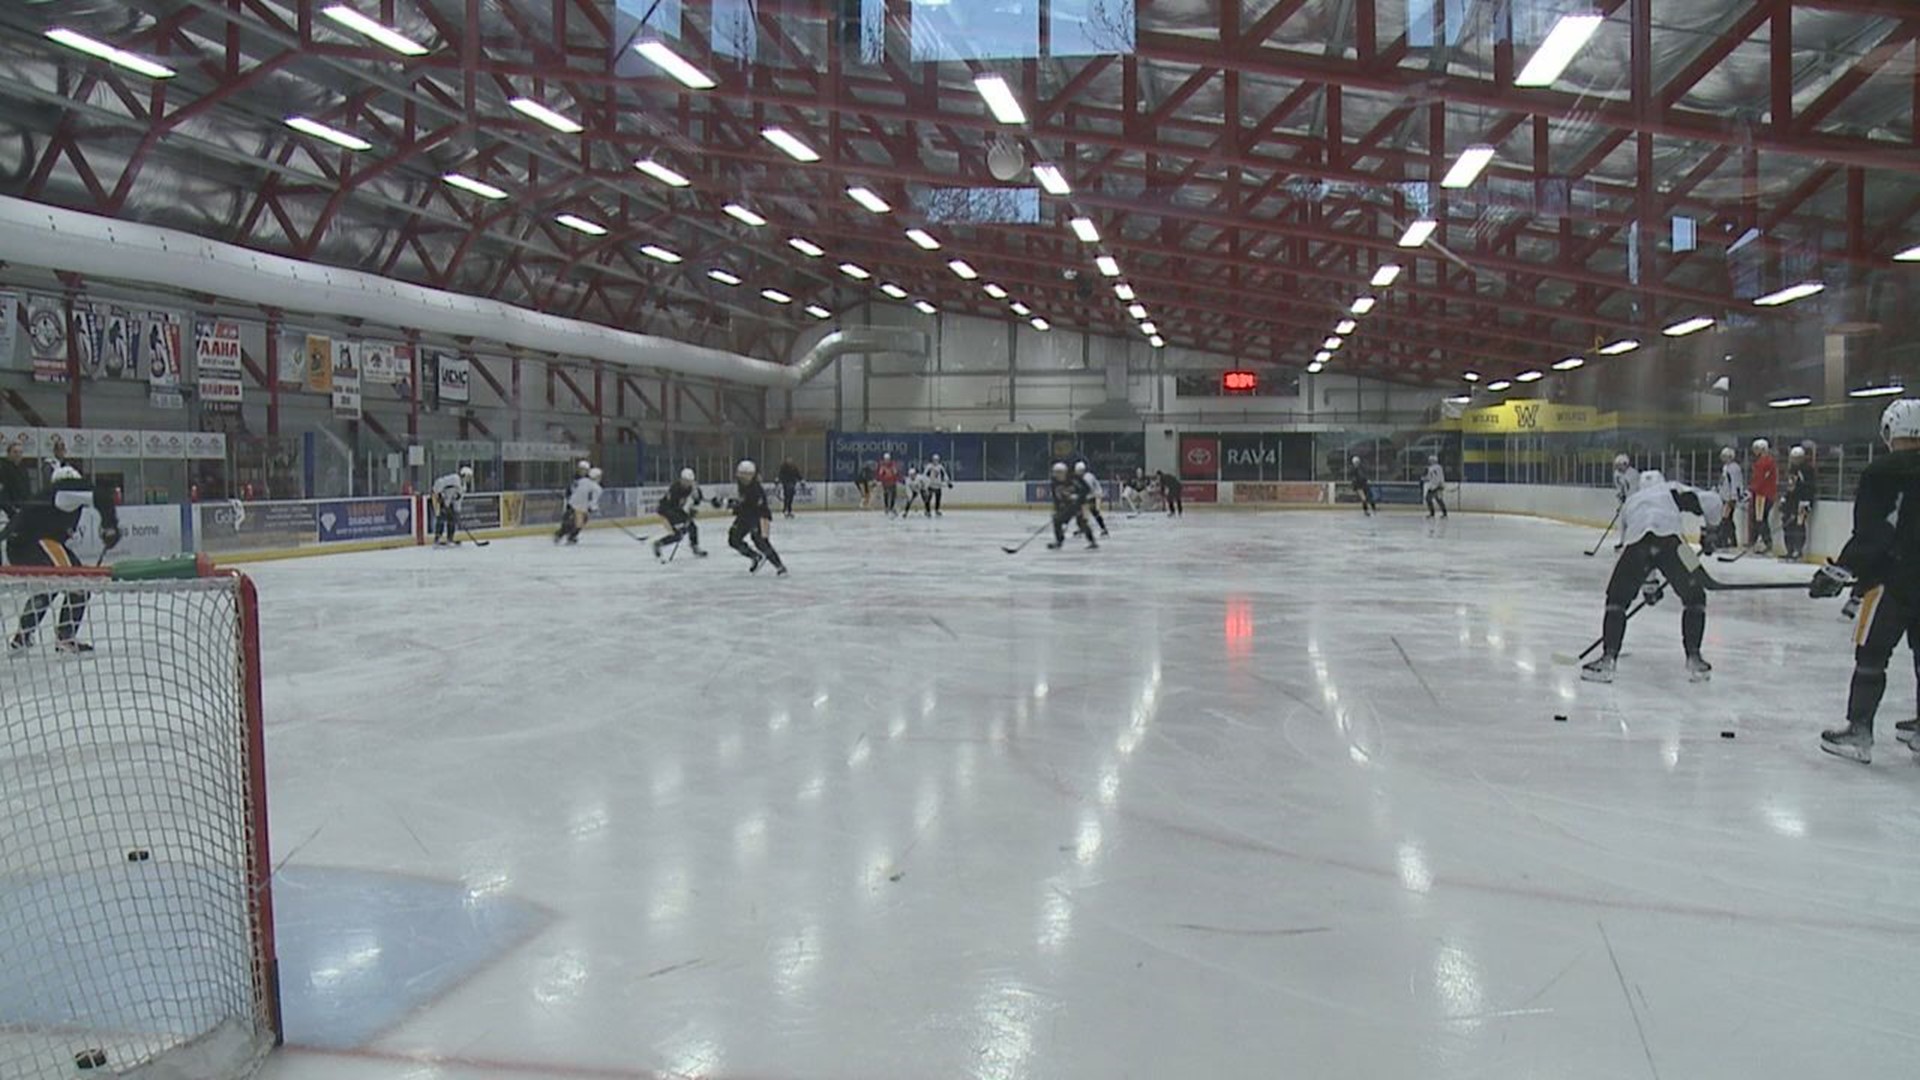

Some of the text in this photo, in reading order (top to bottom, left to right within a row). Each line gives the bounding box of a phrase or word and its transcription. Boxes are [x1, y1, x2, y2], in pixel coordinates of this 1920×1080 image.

[1514, 404, 1539, 428] W
[836, 437, 908, 454] Supporting
[1227, 448, 1277, 465] RAV4
